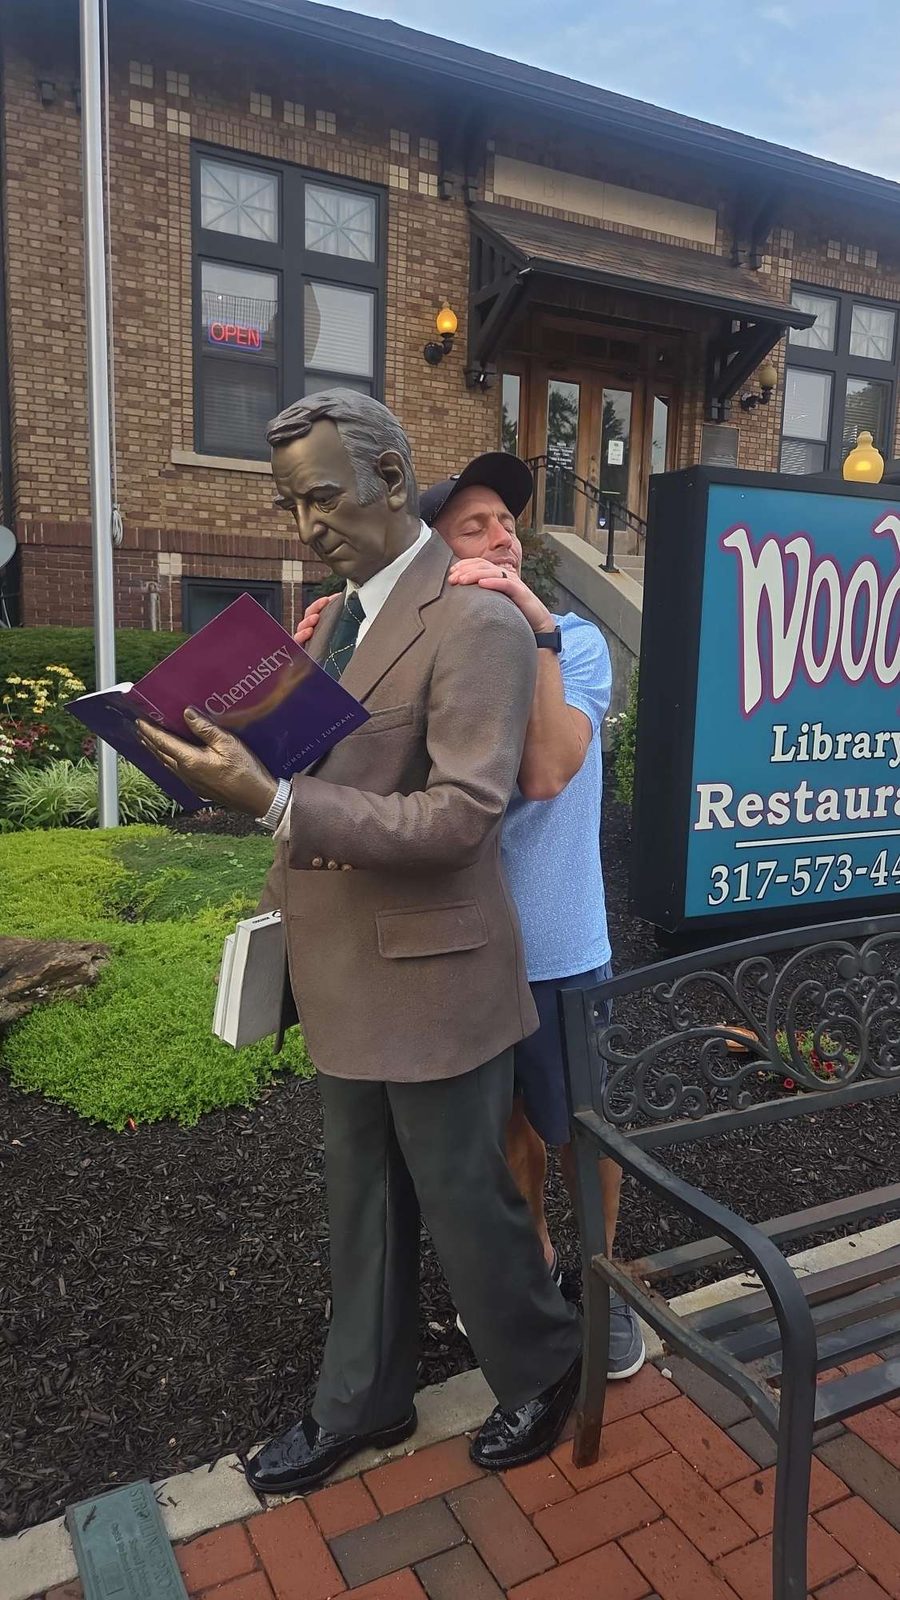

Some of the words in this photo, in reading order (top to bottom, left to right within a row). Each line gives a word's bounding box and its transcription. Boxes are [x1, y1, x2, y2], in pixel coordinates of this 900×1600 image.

[211, 322, 260, 347] OPEN
[204, 645, 294, 715] Chemistry
[321, 712, 355, 738] ZUMDAHL
[694, 781, 900, 831] Restaur
